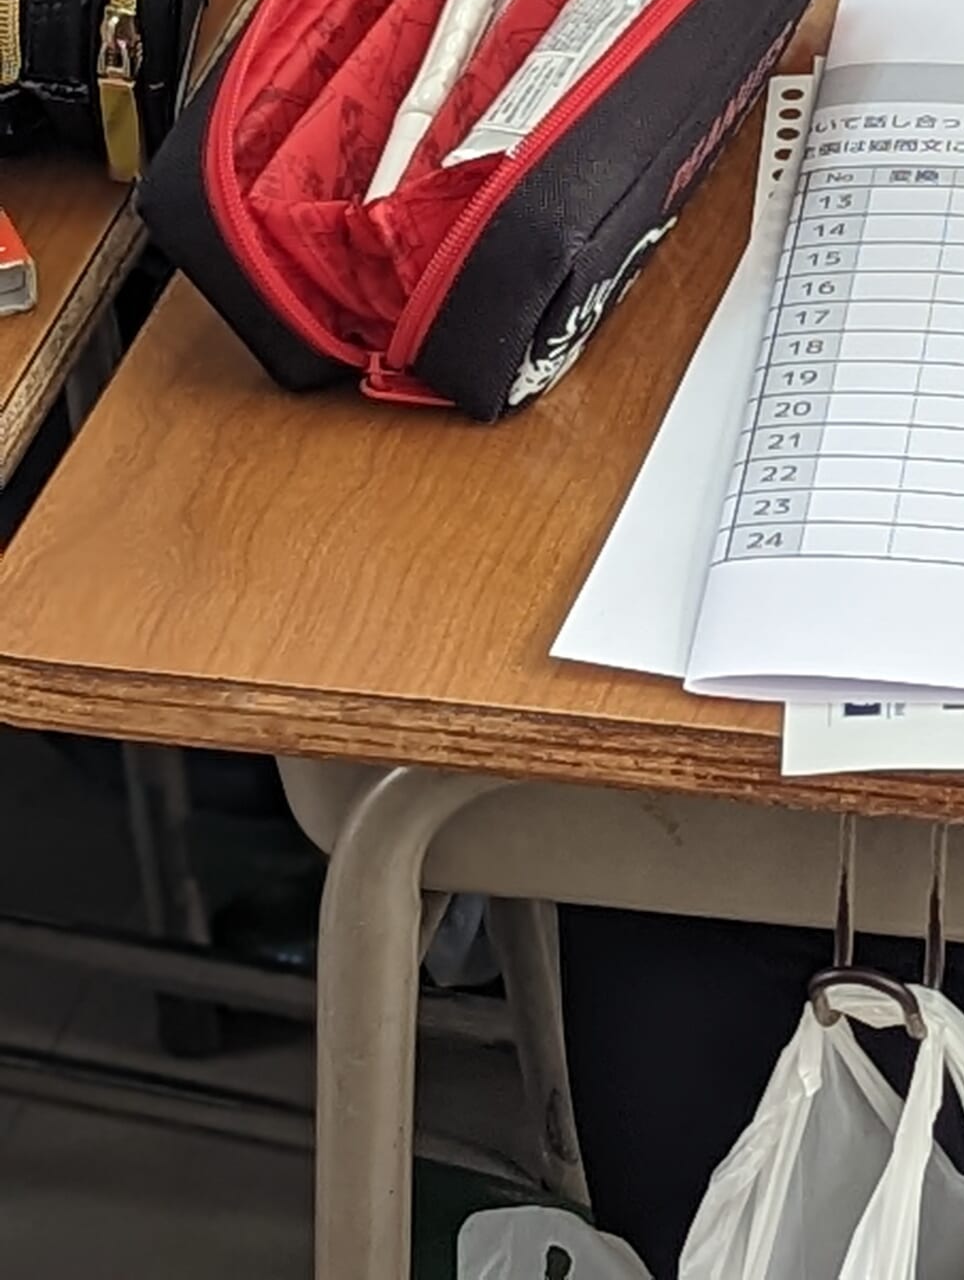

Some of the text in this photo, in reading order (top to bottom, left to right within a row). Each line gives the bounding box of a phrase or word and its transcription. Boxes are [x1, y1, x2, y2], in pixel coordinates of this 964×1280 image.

[825, 170, 855, 184] No
[818, 192, 854, 210] 13
[813, 222, 846, 238] 14
[806, 251, 842, 267] 15
[801, 280, 836, 297] 16
[795, 308, 831, 326] 17
[788, 339, 825, 356] 18
[782, 369, 819, 387] 19
[774, 401, 812, 419] 20
[767, 432, 802, 451] 21
[760, 465, 798, 483] 22
[752, 497, 792, 517] 23
[746, 531, 784, 550] 24
